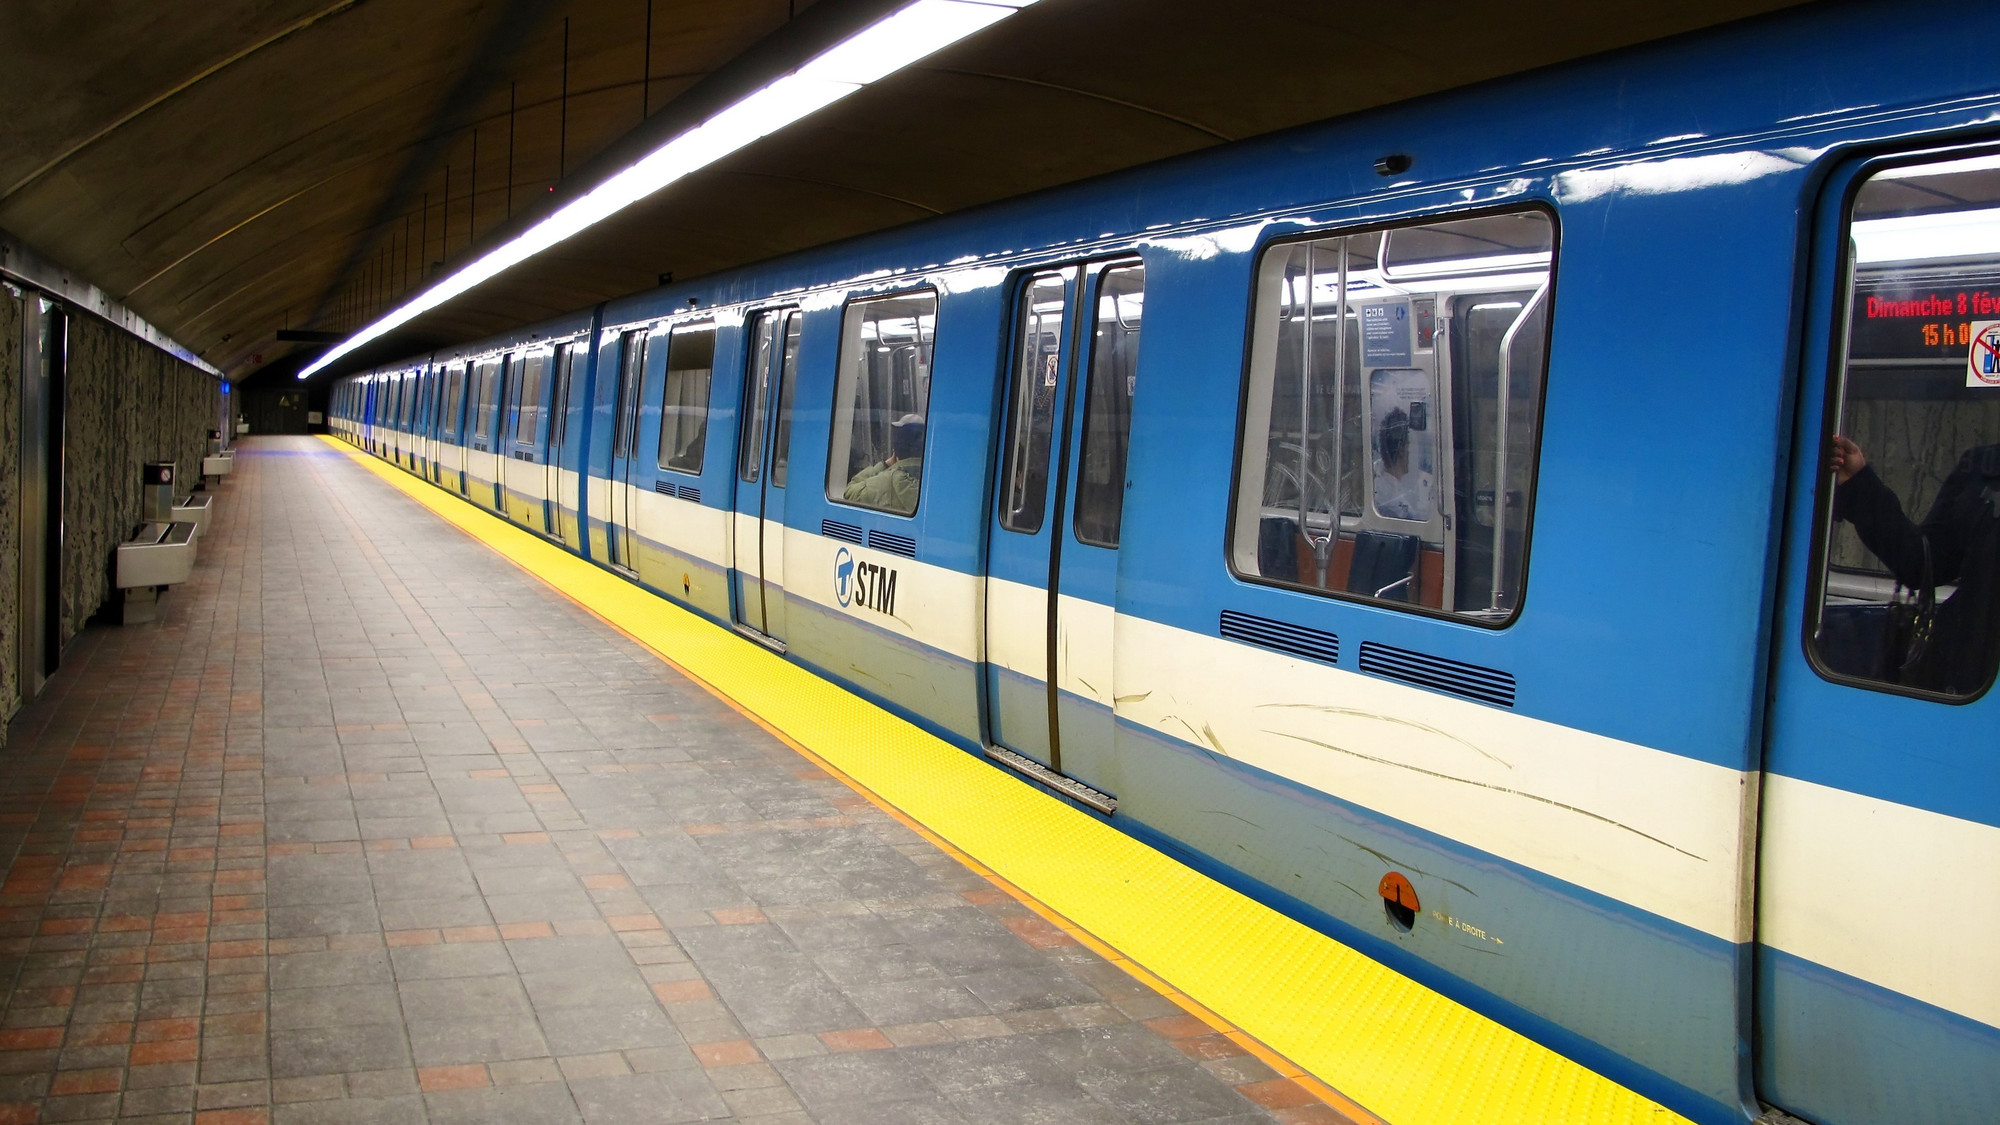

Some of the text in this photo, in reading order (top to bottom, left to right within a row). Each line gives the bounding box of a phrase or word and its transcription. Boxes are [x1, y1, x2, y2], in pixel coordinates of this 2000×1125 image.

[1867, 294, 1952, 318] Dimanche
[1957, 292, 1967, 315] 8
[1921, 323, 1939, 346] 15
[1943, 323, 1955, 345] h
[855, 561, 897, 616] STM
[1461, 922, 1486, 940] DROITE
